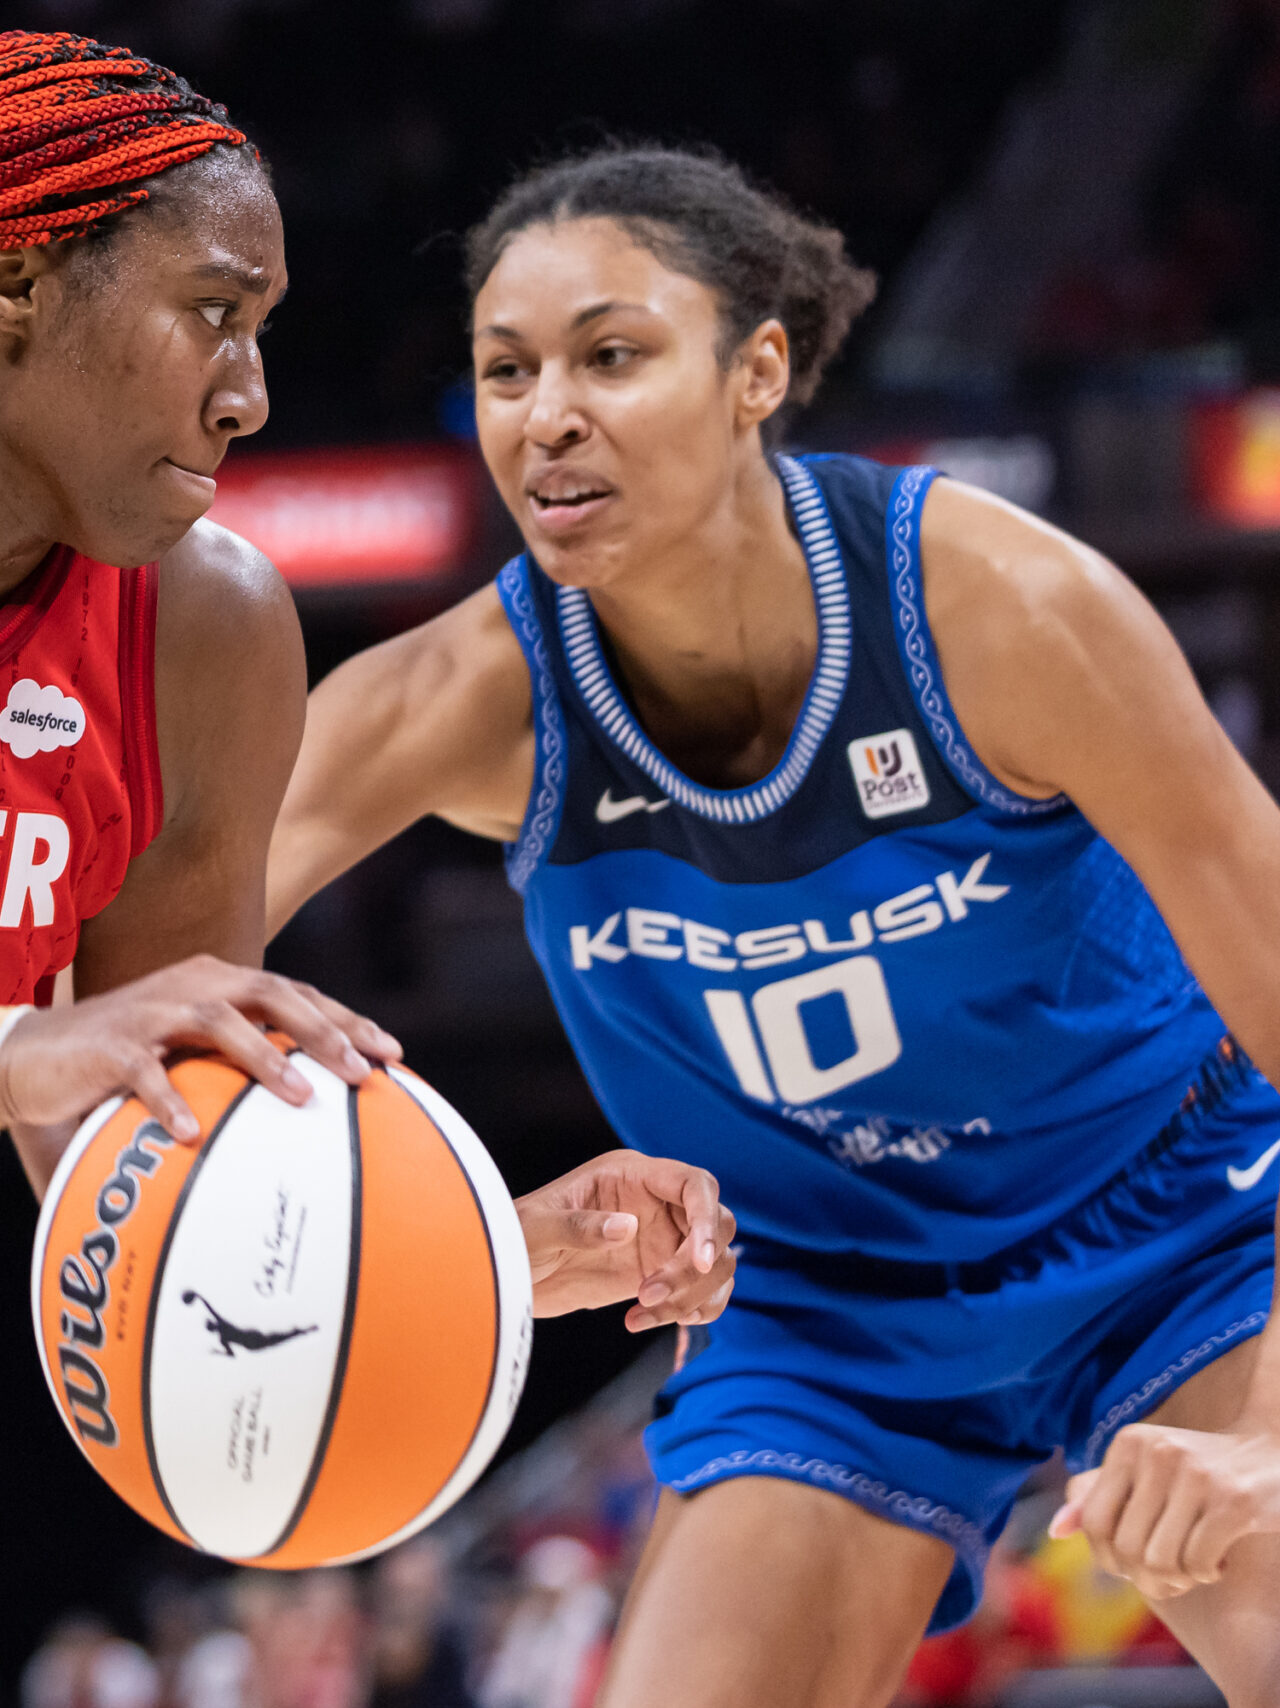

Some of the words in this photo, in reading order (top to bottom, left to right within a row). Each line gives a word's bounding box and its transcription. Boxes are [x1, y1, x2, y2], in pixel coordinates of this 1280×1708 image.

[10, 708, 77, 733] salesforce
[570, 852, 1010, 972] KEESUSK
[704, 955, 903, 1105] 10
[57, 1117, 177, 1448] Wilson
